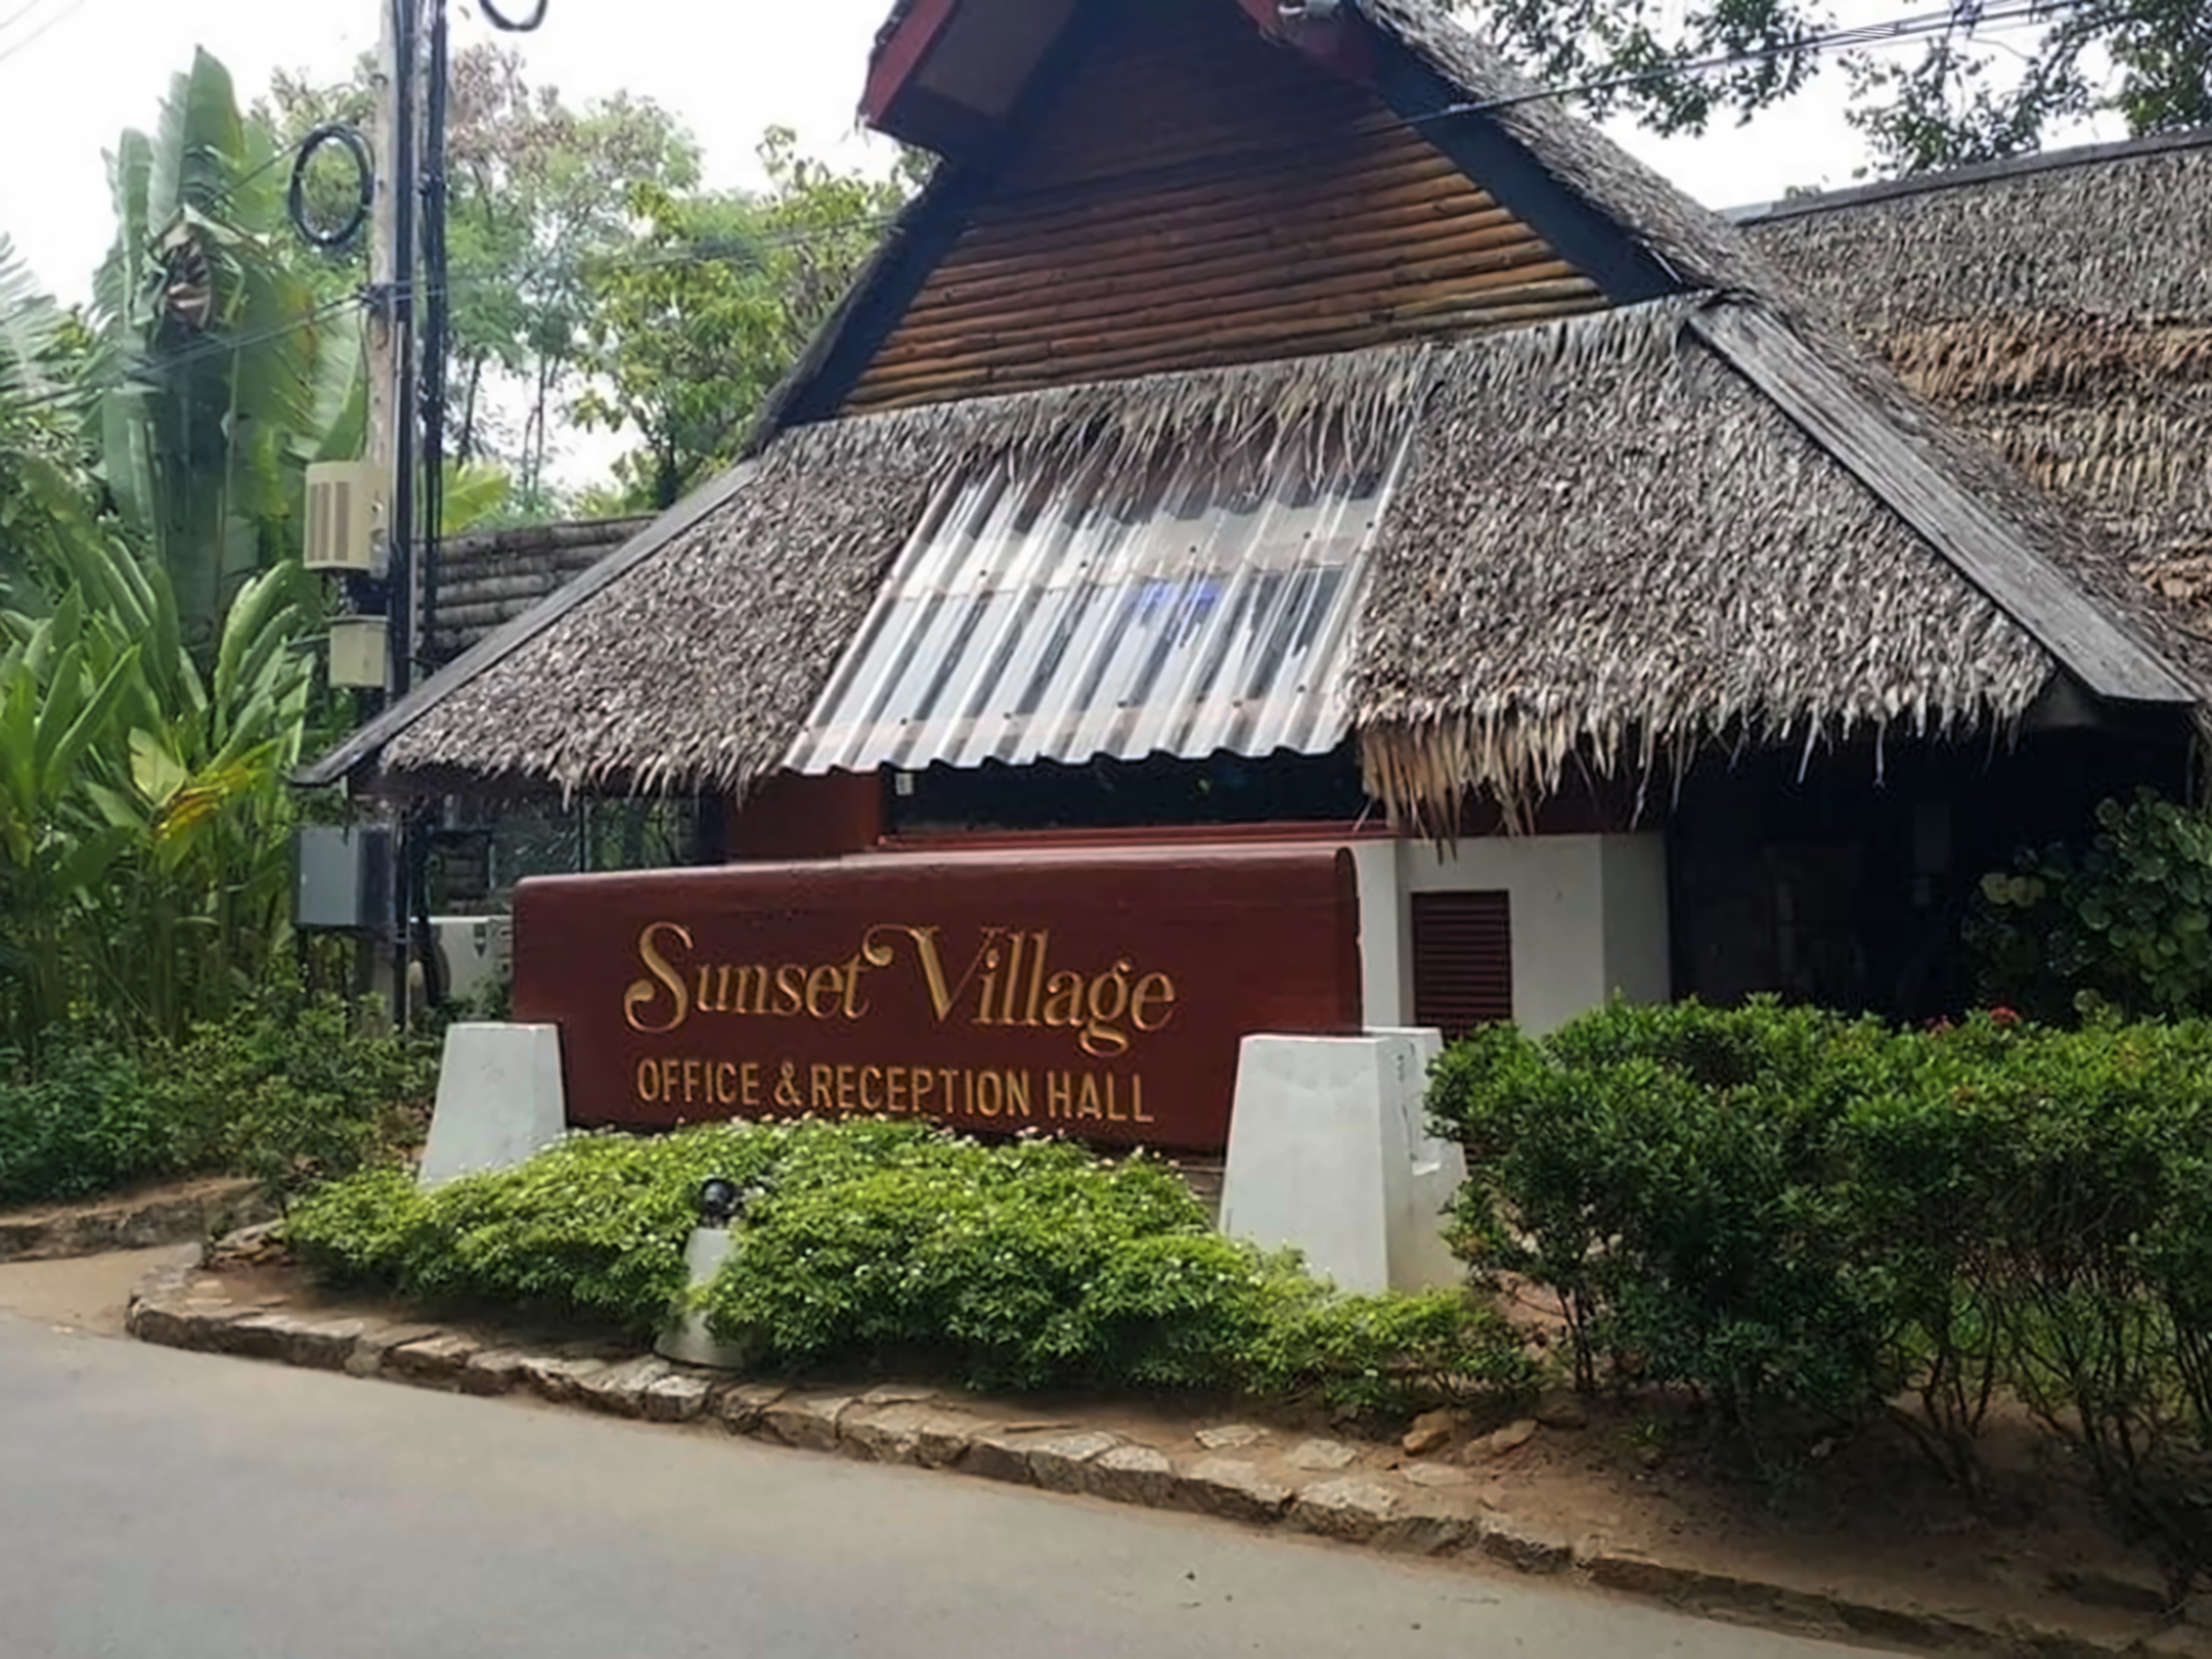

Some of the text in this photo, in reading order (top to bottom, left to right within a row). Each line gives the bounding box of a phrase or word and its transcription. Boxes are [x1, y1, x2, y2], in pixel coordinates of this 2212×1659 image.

[624, 921, 1175, 1057] Sunset Village
[637, 1058, 1154, 1123] OFFICE & RECEPTION HALL
